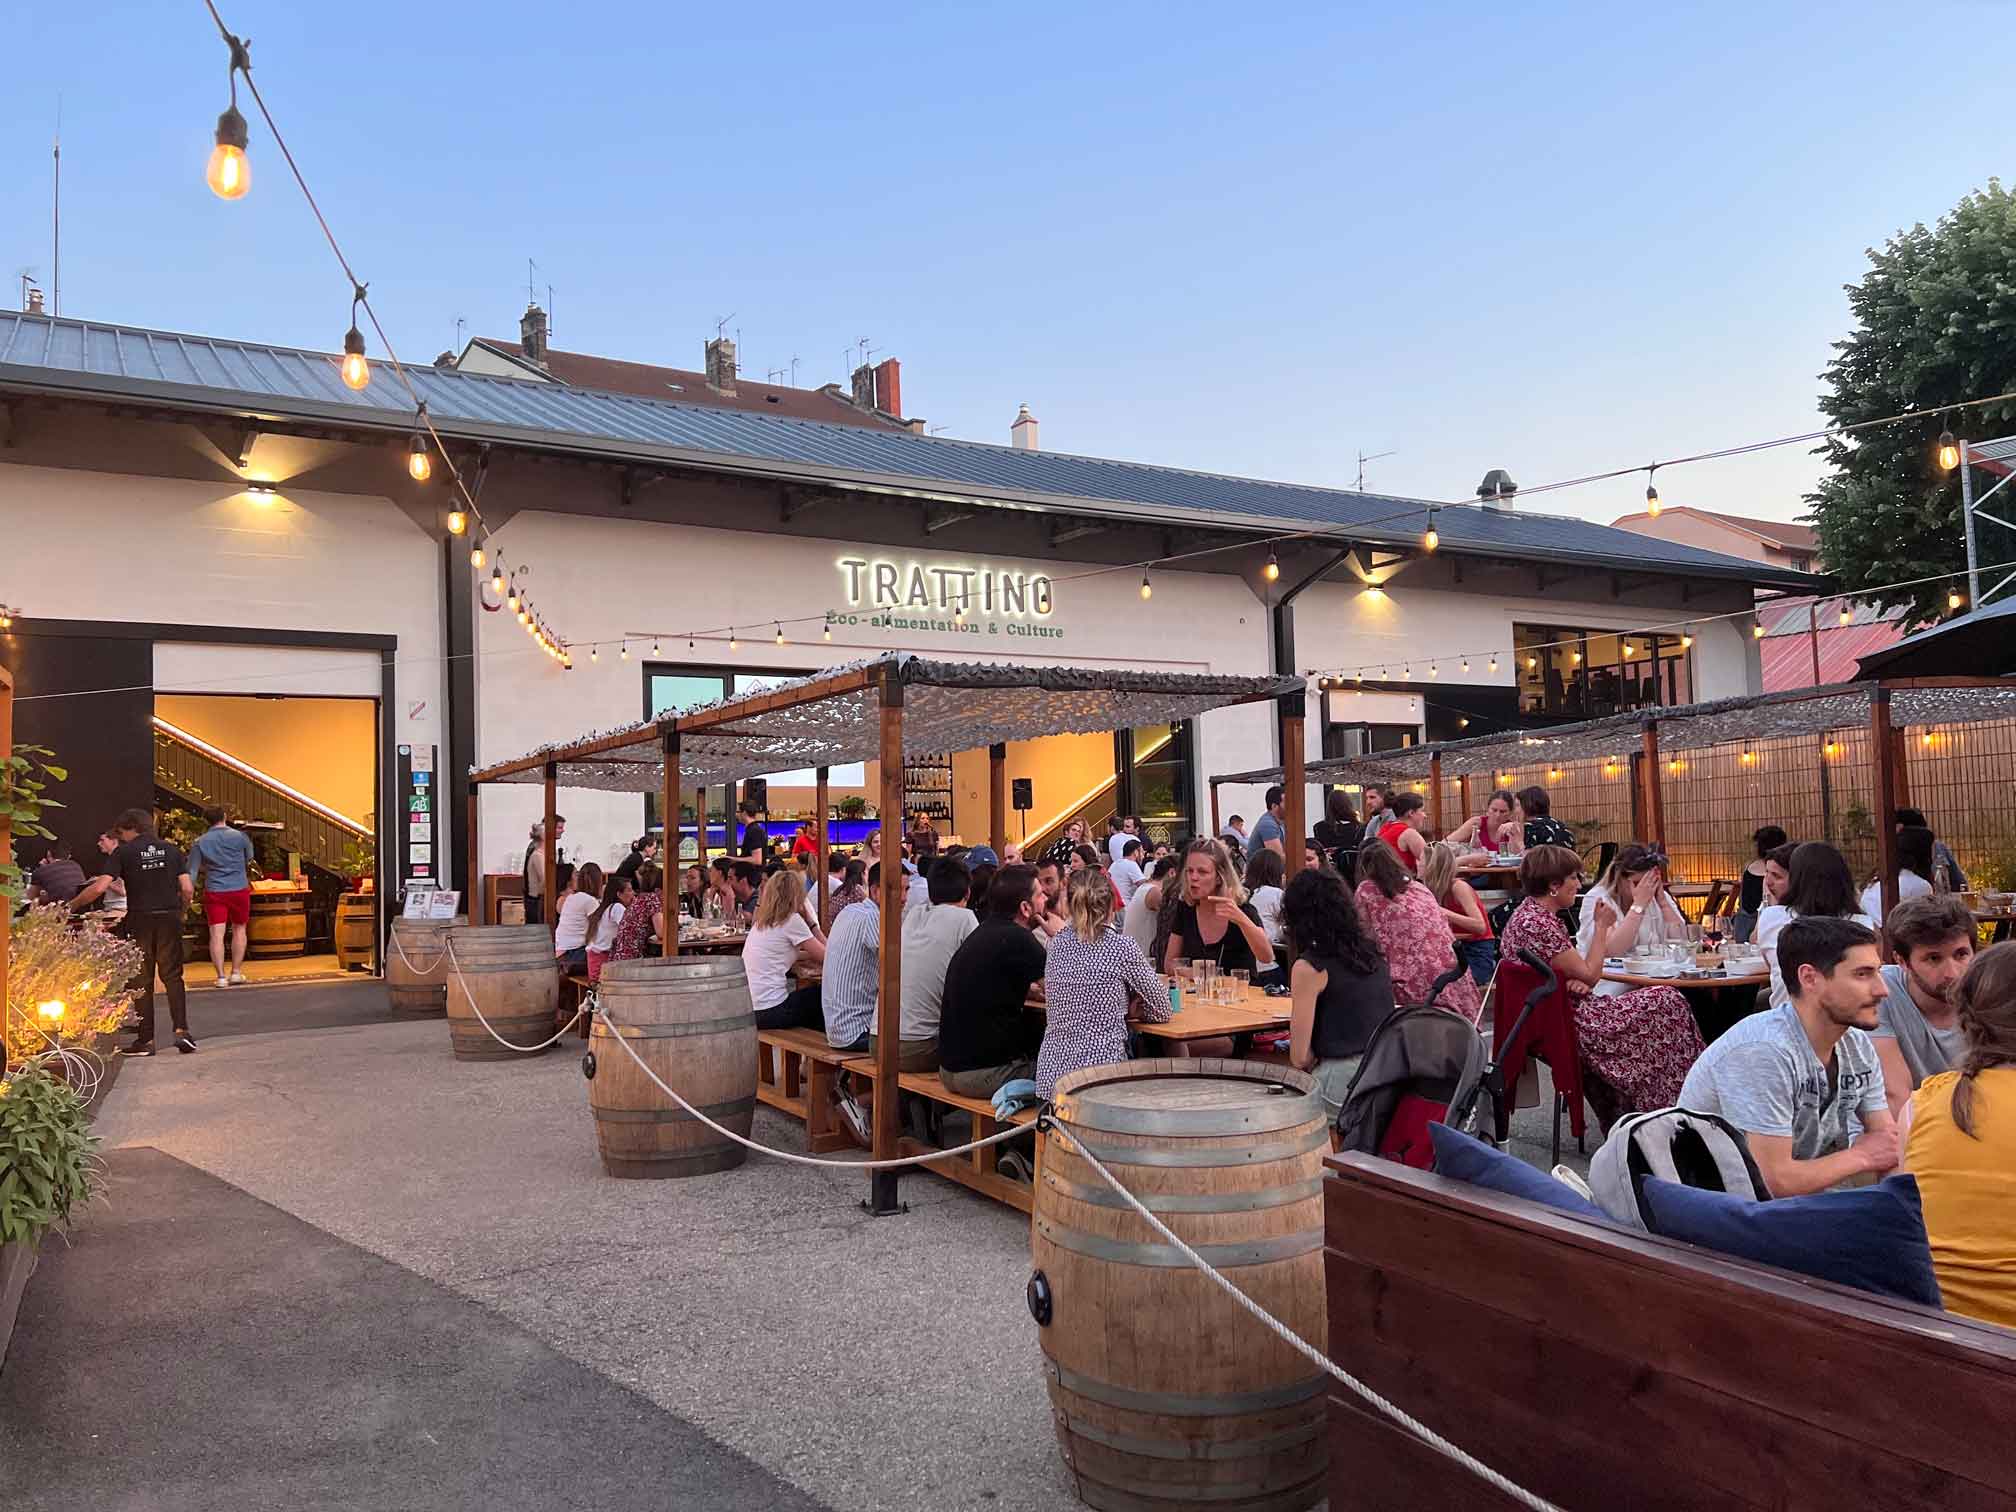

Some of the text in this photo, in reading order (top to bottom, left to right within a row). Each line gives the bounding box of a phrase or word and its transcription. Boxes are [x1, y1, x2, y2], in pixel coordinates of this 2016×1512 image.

[842, 560, 1052, 614] TRATTINO
[989, 622, 998, 634] &
[1006, 623, 1064, 638] Culture
[410, 798, 428, 812] AB
